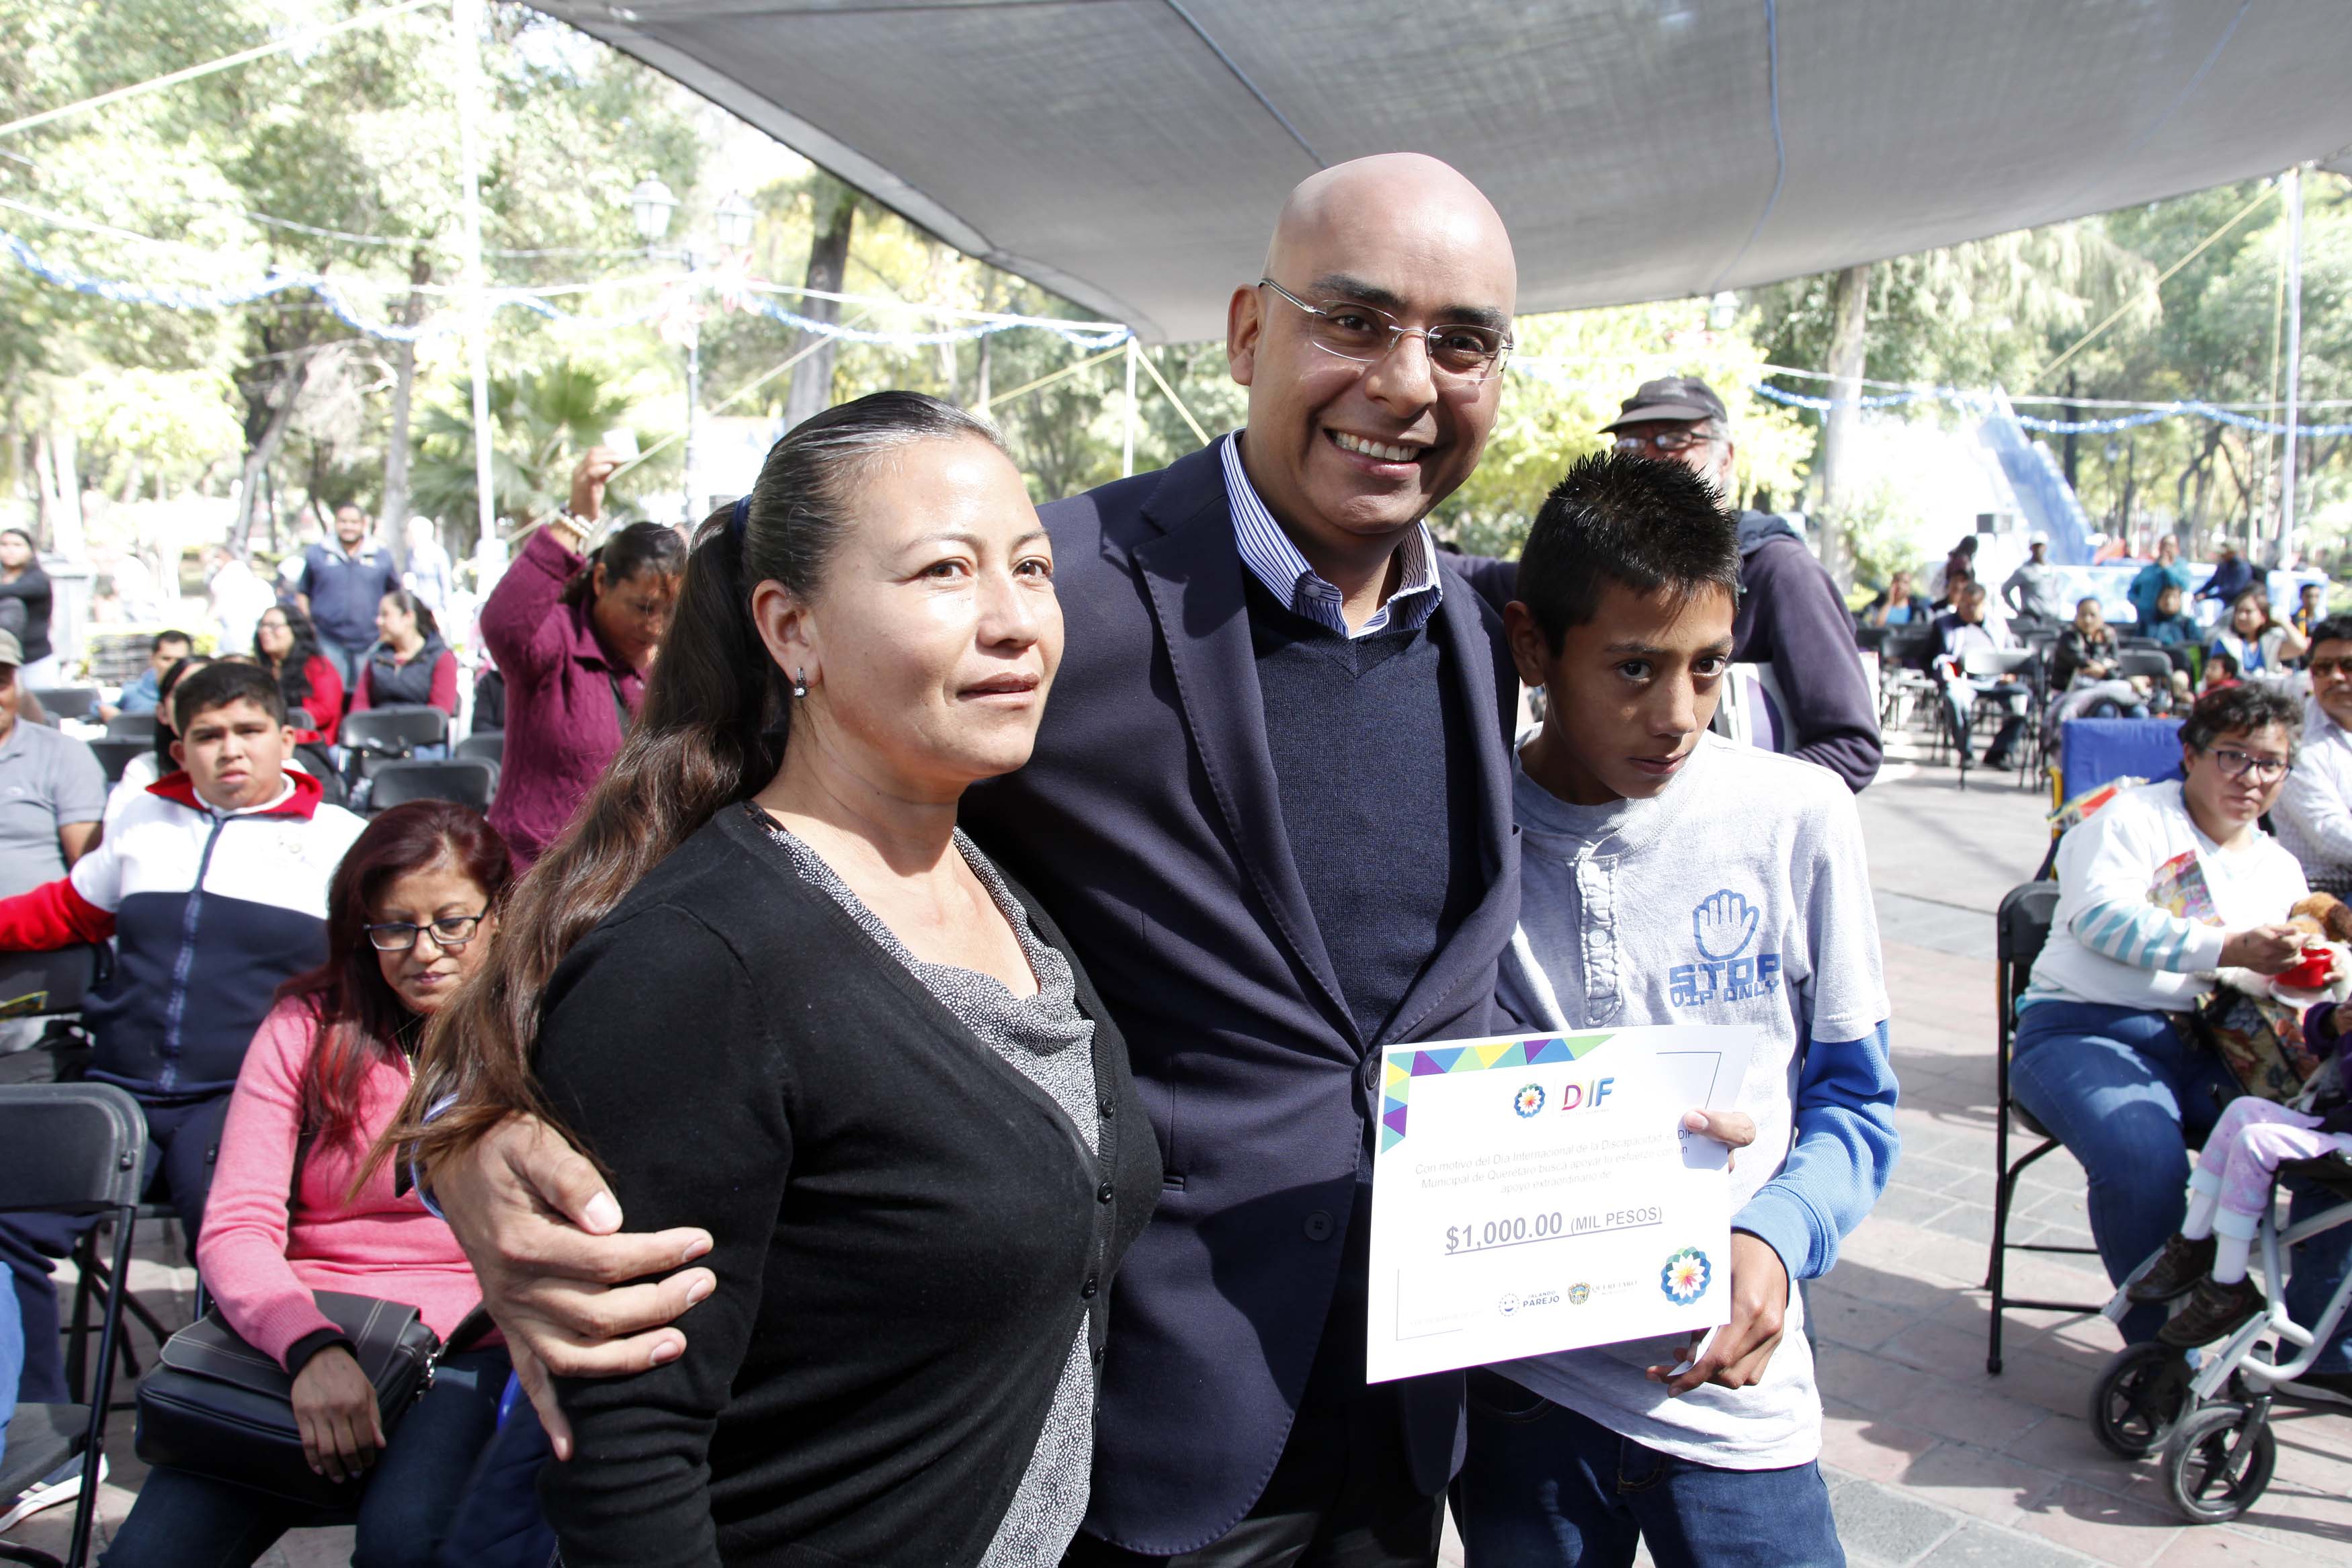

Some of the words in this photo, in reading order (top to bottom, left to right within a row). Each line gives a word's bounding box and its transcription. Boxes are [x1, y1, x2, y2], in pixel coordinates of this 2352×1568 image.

[1669, 953, 1780, 990] STOP
[1724, 979, 1779, 1002] ONLY
[1561, 1077, 1615, 1110] DIF
[1415, 1163, 1436, 1174] Con
[1439, 1160, 1472, 1171] motivo
[1475, 1154, 1490, 1166] del
[1513, 1144, 1574, 1162] Internacional
[1576, 1141, 1587, 1153] de
[1591, 1141, 1599, 1151] la
[1422, 1172, 1469, 1188] Municipal
[1472, 1172, 1484, 1182] de
[1538, 1161, 1567, 1174] busca
[1569, 1156, 1601, 1171] apoyar
[1656, 1147, 1673, 1158] con
[1501, 1182, 1531, 1196] apoyo
[1533, 1172, 1597, 1188] extraordinario
[1599, 1168, 1611, 1180] de
[1446, 1212, 1562, 1254] $1,000.00
[1570, 1215, 1601, 1235] (MIL
[1606, 1207, 1662, 1226] PESOS)
[1523, 1295, 1560, 1307] PAREJO
